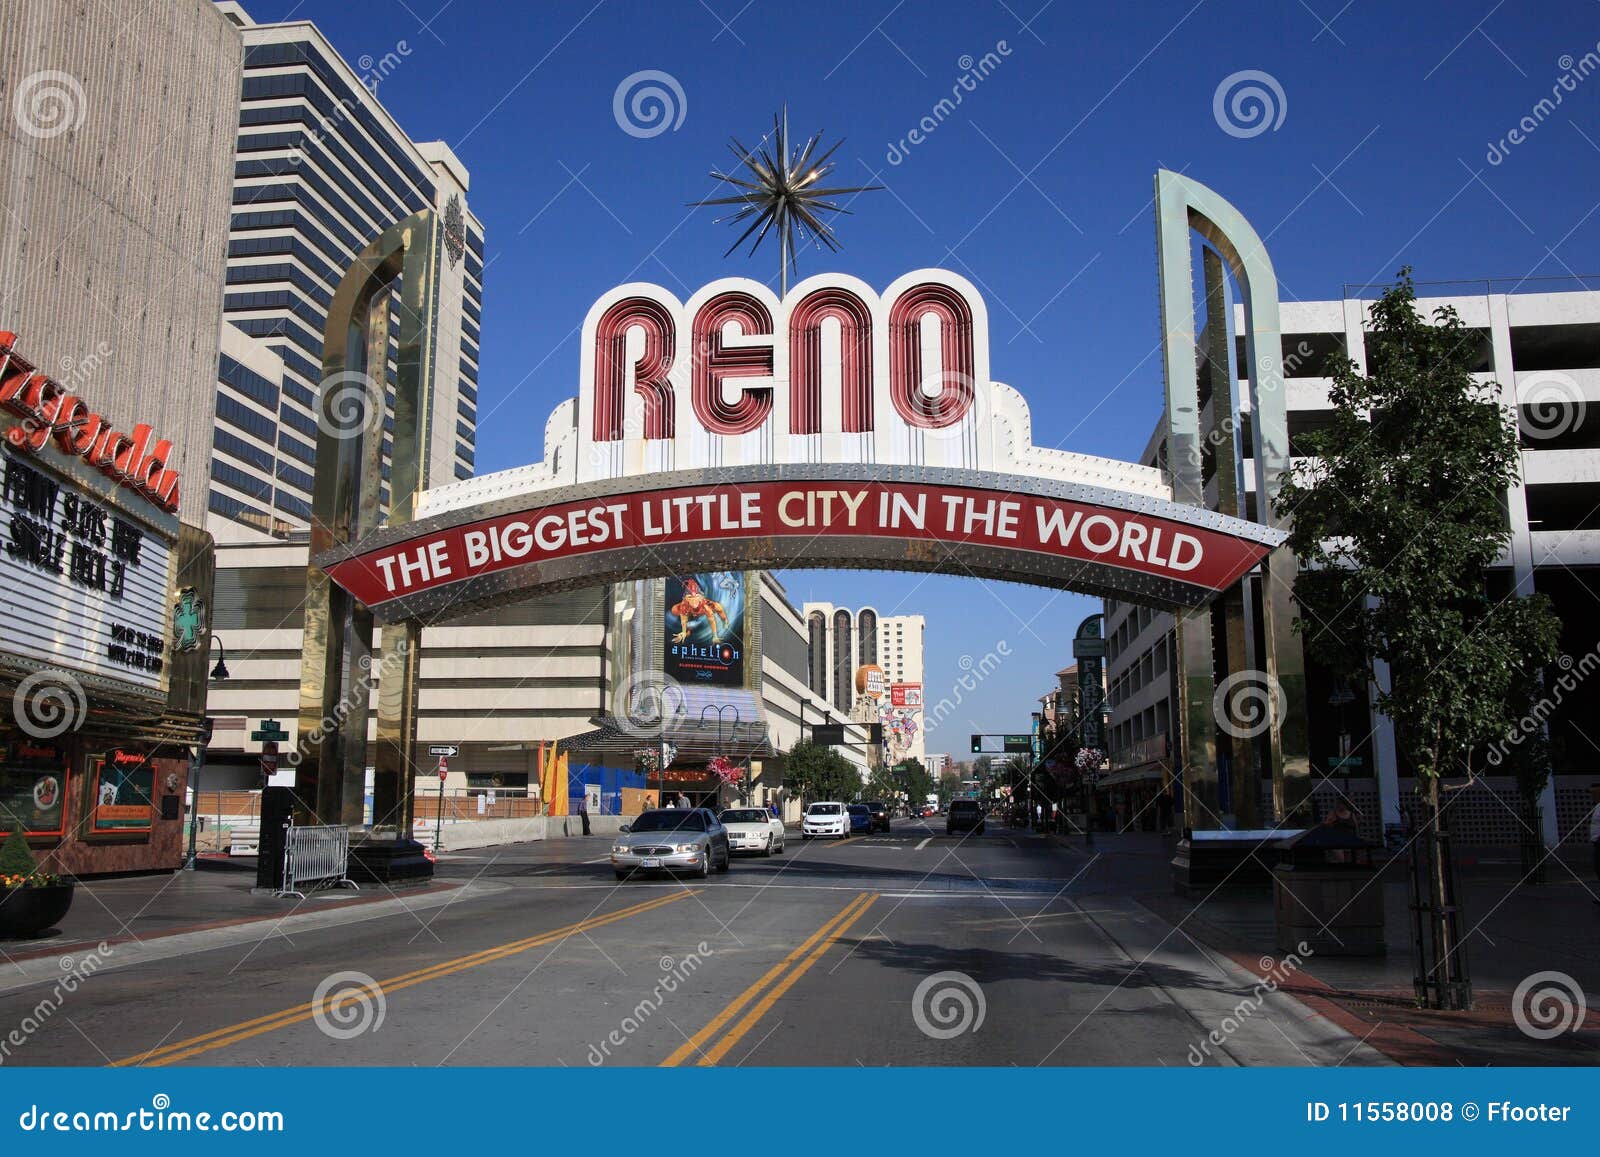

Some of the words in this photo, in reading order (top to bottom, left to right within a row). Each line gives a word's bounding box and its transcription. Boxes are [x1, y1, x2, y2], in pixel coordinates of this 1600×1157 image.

[593, 282, 975, 442] RENO
[375, 540, 452, 593] THE
[464, 503, 629, 568] BIGGEST
[642, 492, 761, 536] LITTLE
[778, 490, 871, 527] CITY
[878, 493, 926, 529] IN
[942, 495, 1021, 539] THE
[1035, 506, 1204, 572] WORLD
